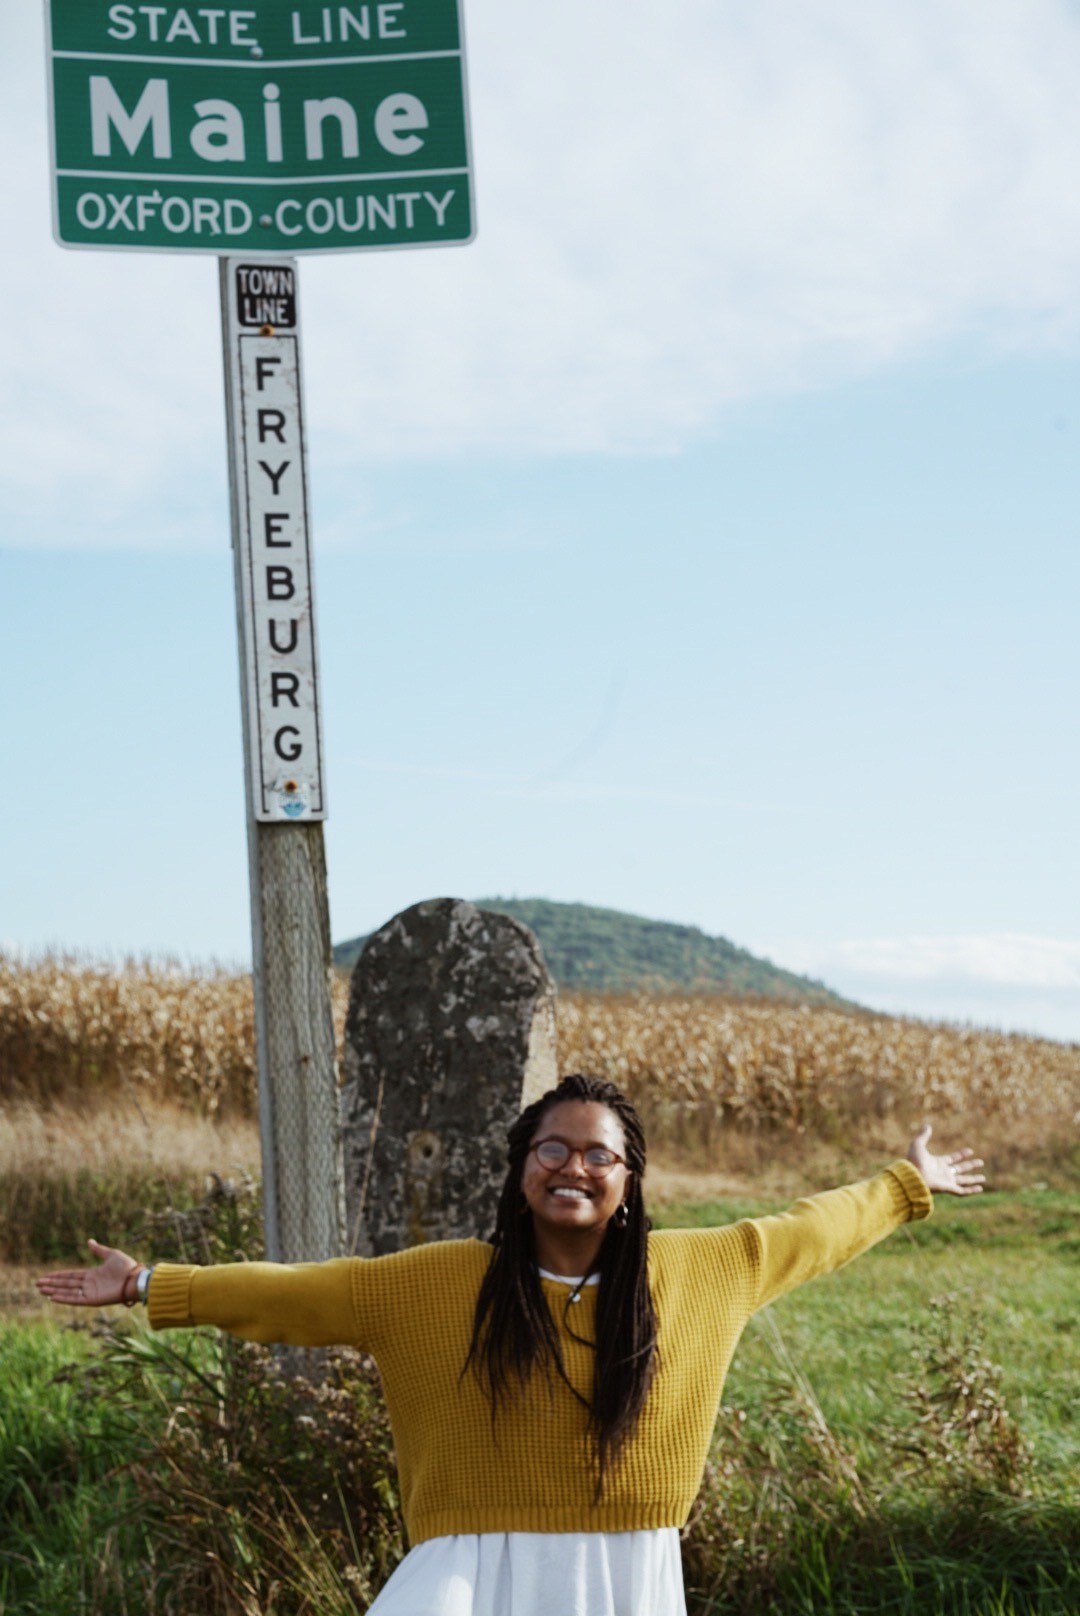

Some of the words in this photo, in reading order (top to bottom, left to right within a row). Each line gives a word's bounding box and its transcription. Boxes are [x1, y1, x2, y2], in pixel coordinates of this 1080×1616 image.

[107, 4, 258, 46] STATE
[292, 4, 407, 45] LINE
[89, 75, 429, 162] Maine
[76, 190, 253, 236] OXFORD
[275, 190, 456, 236] COUNTY
[237, 268, 293, 296] TOWN
[244, 298, 290, 325] LINE
[255, 356, 303, 762] FRYEBURG
